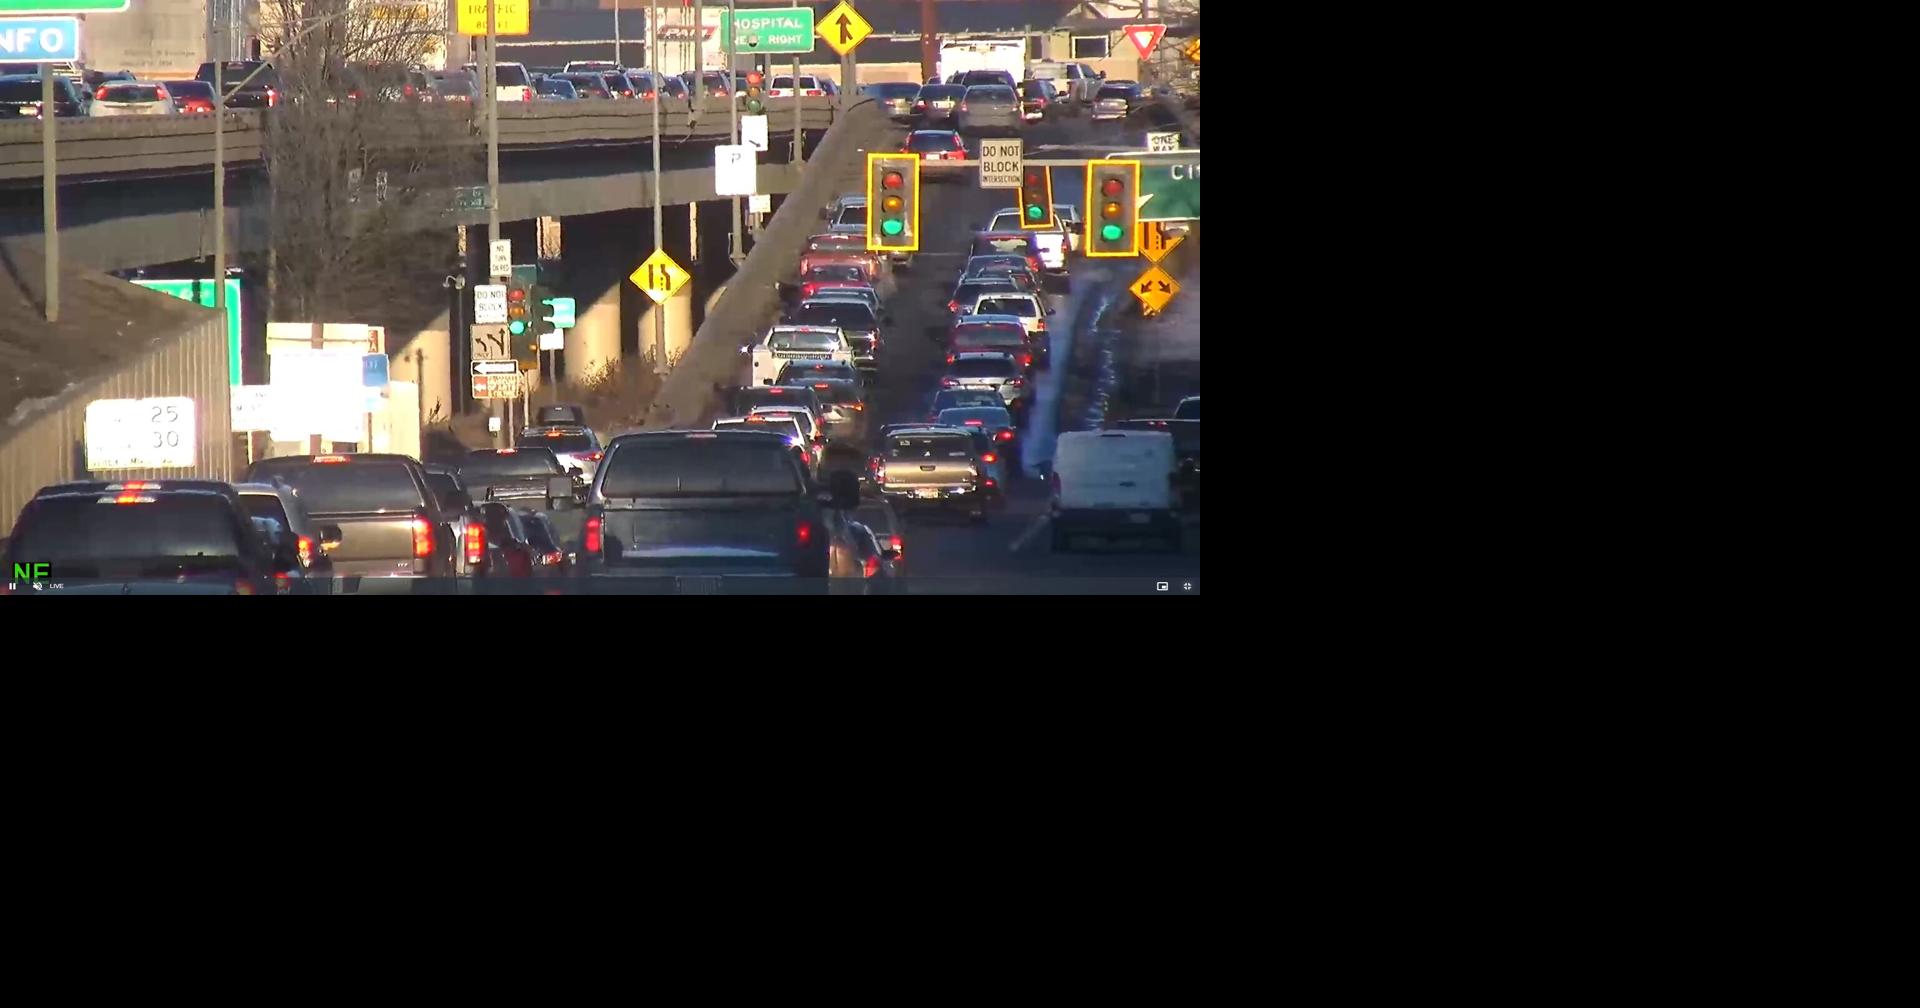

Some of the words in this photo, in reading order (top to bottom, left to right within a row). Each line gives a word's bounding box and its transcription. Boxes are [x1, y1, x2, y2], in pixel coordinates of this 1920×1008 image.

[768, 35, 803, 45] RIGHT
[1152, 135, 1173, 145] ONE
[983, 146, 997, 157] DO
[1000, 146, 1020, 157] NOT
[983, 161, 1019, 173] BLOCK
[982, 175, 1020, 184] INTERSECTION
[476, 291, 488, 300] DO
[151, 405, 179, 423] 25
[153, 430, 179, 449] 30
